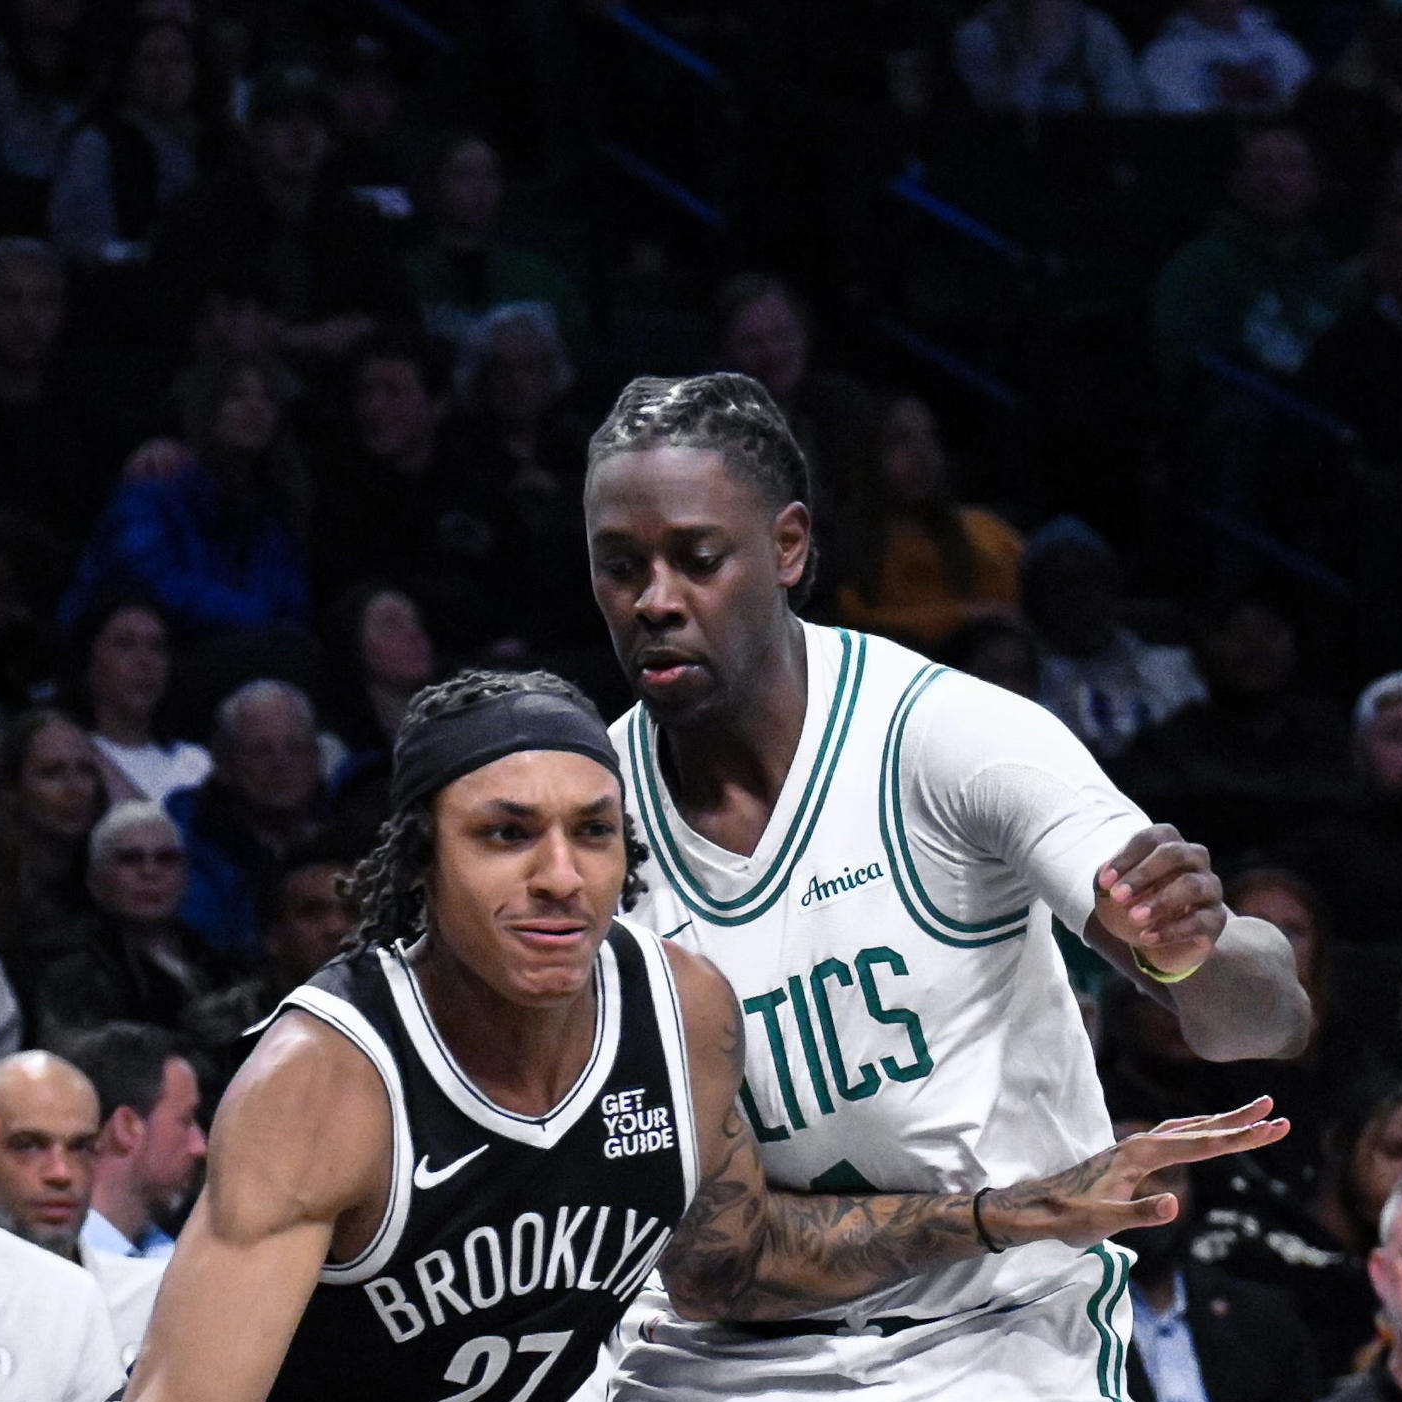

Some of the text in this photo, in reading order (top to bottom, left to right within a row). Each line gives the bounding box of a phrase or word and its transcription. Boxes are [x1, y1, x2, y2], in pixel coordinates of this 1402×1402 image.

[801, 862, 884, 906] Amica
[739, 946, 934, 1144] LTICS
[601, 1088, 646, 1115] GET
[602, 1107, 669, 1137] YOUR
[604, 1127, 675, 1159] GUIDE
[364, 1205, 674, 1343] BROOKLYN
